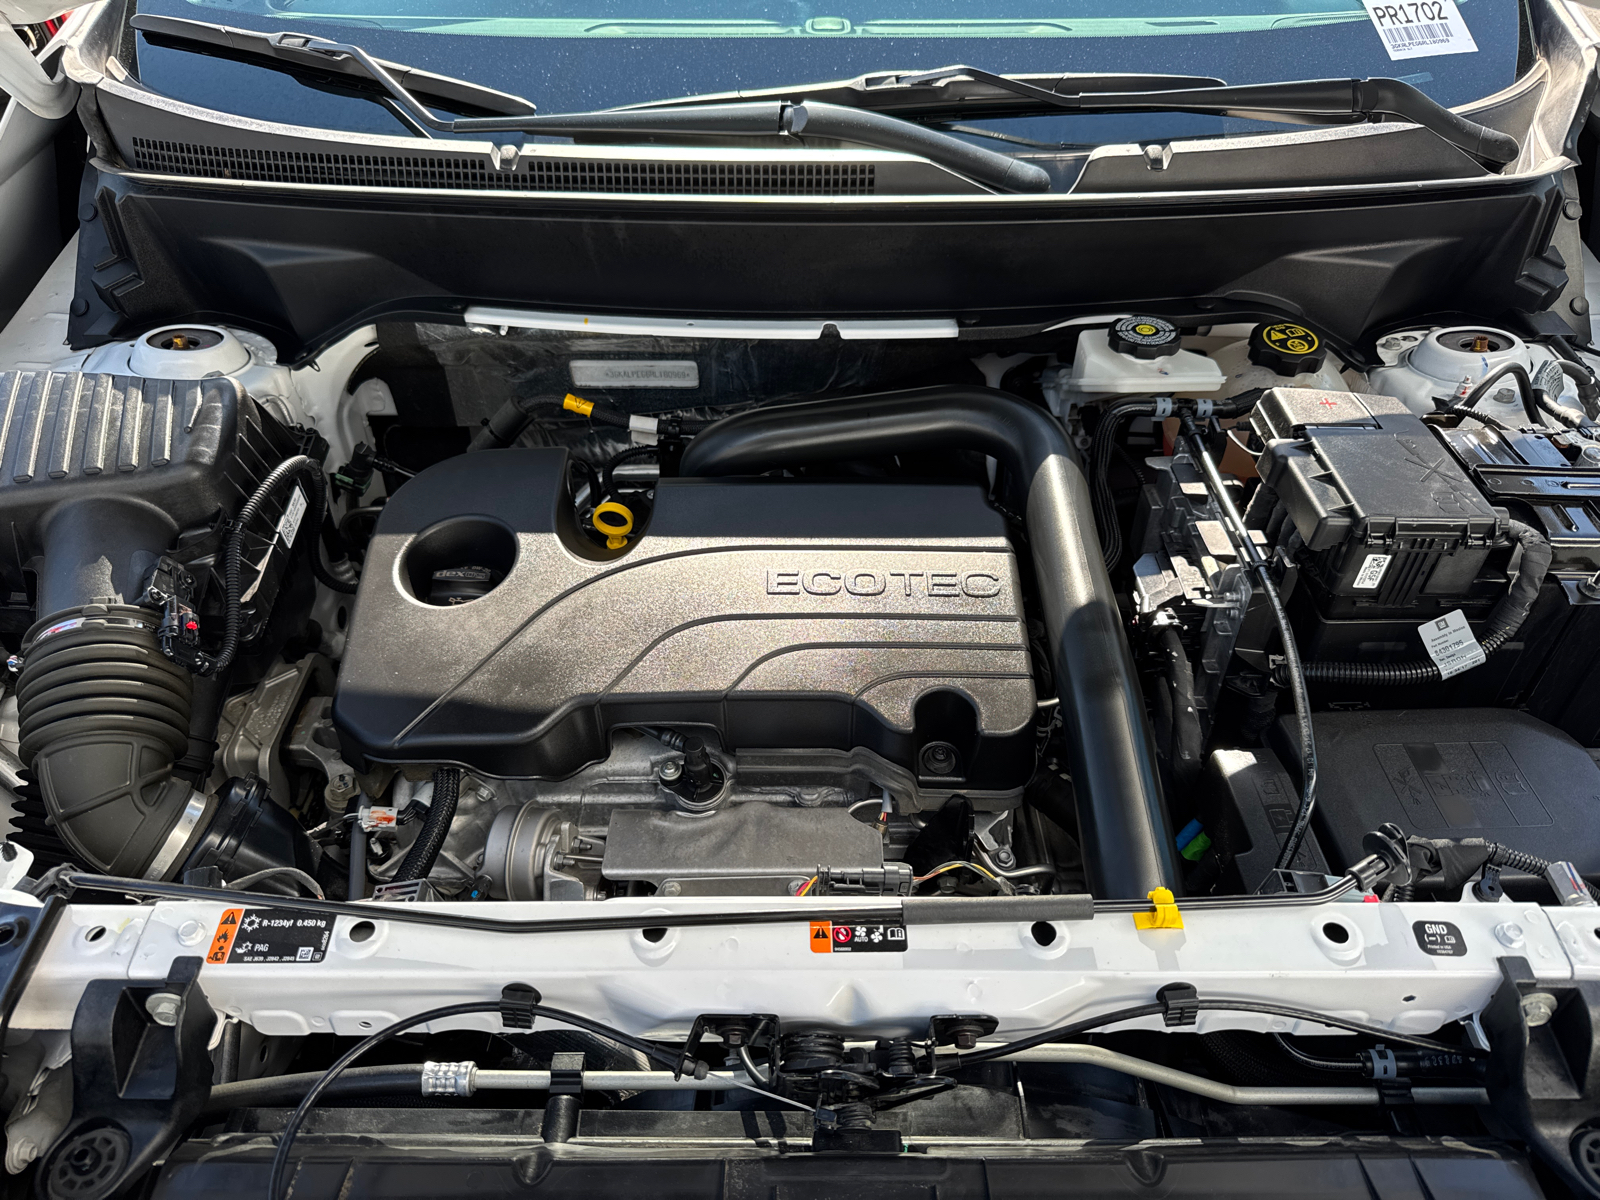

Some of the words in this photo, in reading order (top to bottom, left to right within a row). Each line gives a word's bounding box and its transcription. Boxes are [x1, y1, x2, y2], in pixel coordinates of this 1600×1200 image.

[1372, 2, 1449, 27] PR1702
[766, 569, 1001, 598] ECOTEC
[262, 919, 294, 928] R-1234yf
[296, 919, 316, 927] 0.450
[316, 920, 327, 929] kg
[1424, 924, 1448, 934] GND
[254, 943, 269, 952] PAG
